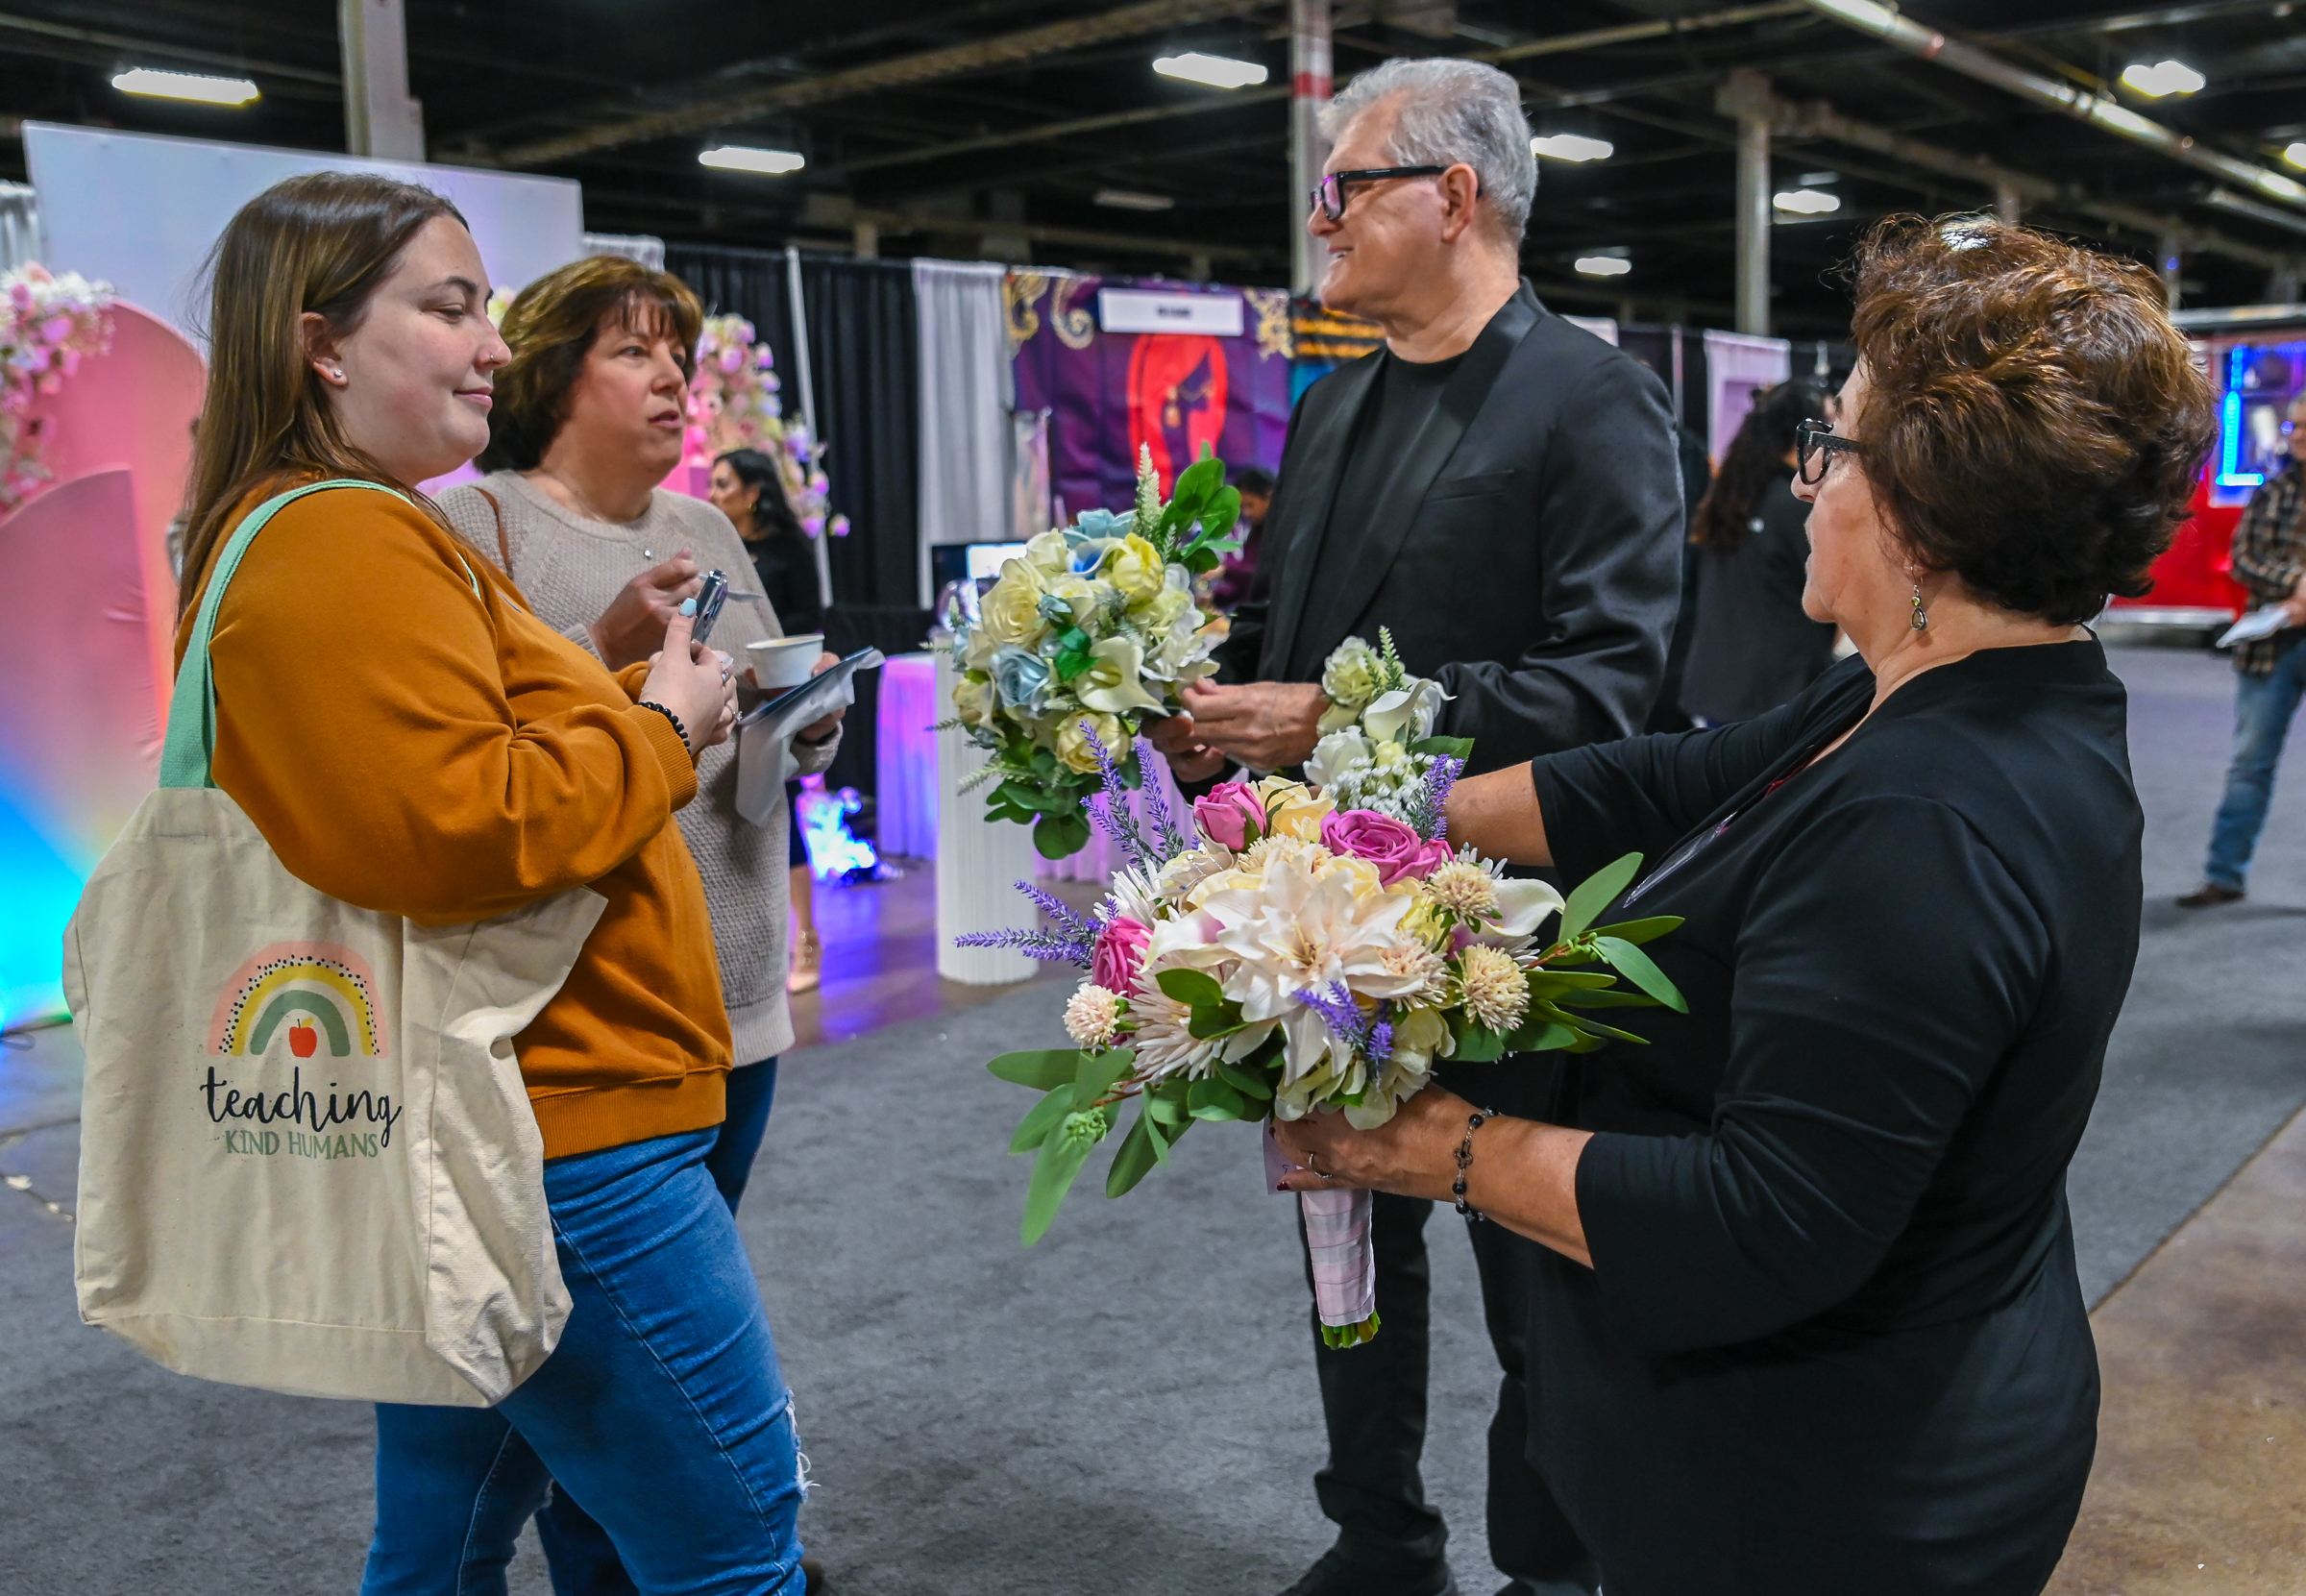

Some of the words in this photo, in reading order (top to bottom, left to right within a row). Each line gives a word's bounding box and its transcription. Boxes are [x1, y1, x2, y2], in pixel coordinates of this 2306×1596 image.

[200, 1066, 403, 1147] teaching
[225, 1130, 280, 1156] KIND
[288, 1130, 379, 1160] HUMANS
